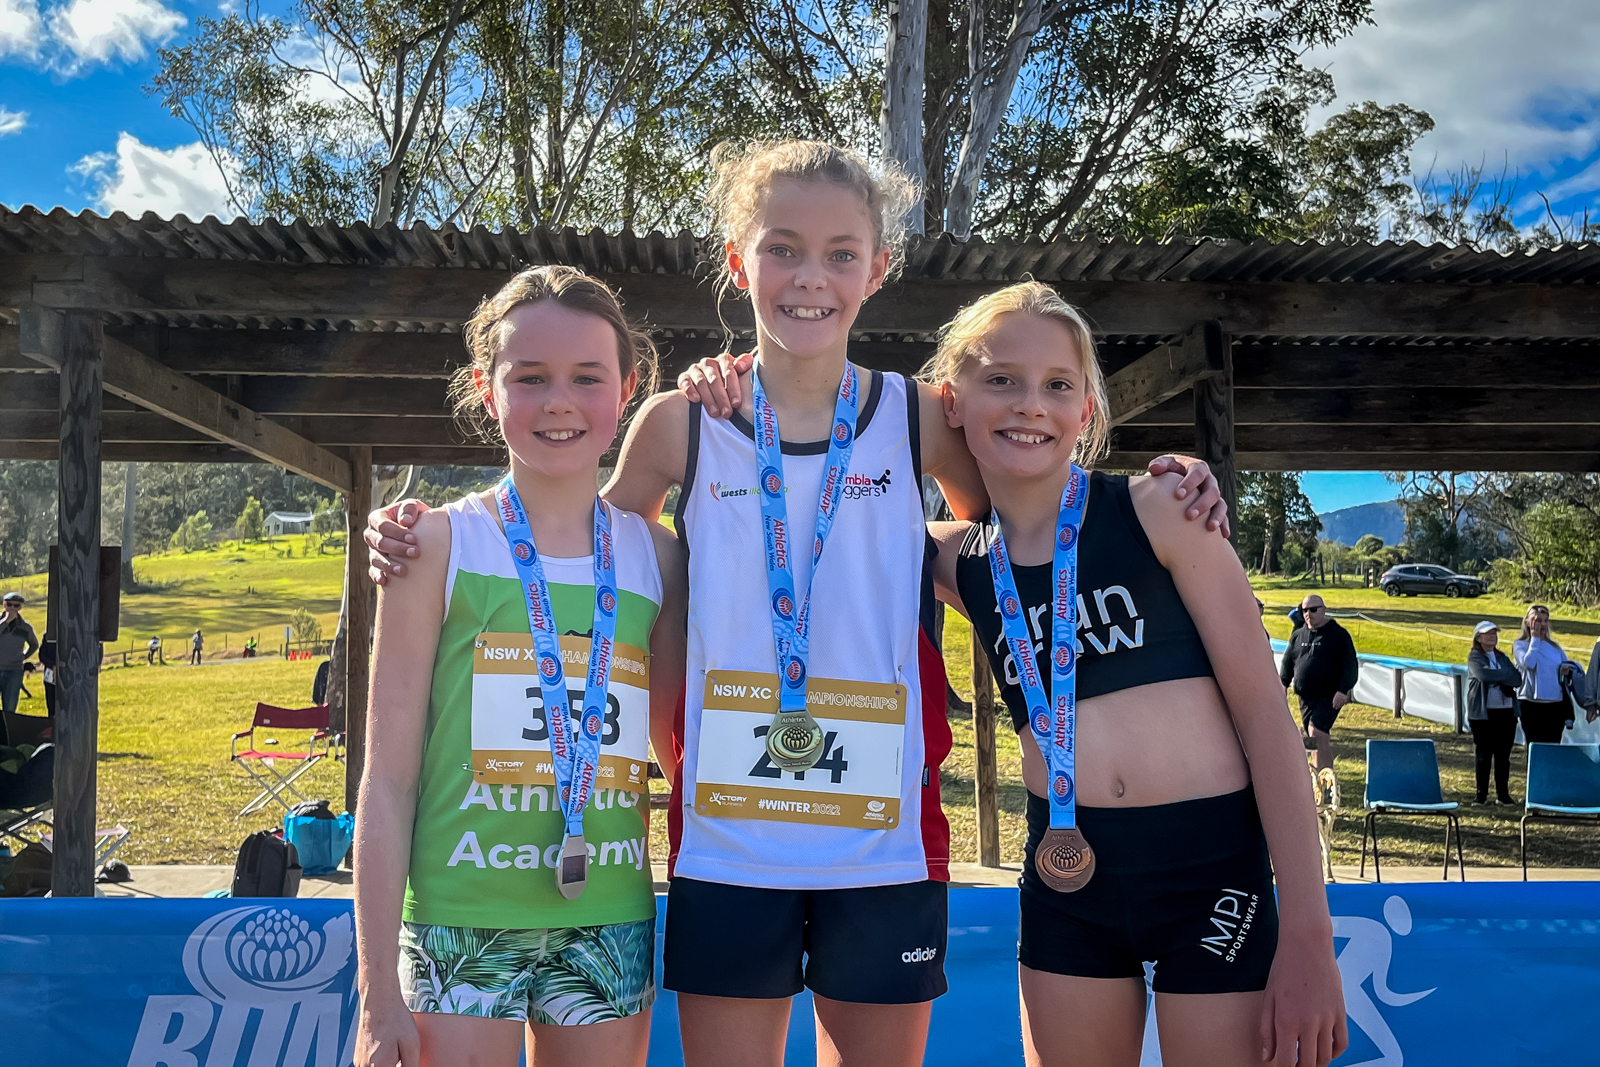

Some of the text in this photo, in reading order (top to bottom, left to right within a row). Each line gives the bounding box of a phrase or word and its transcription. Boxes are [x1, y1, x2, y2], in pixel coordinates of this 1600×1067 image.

[762, 400, 776, 448] Athletics
[721, 488, 748, 498] wests
[819, 465, 838, 516] Athletics
[827, 505, 836, 521] New
[832, 485, 841, 505] South
[1064, 472, 1080, 509] Athletics
[601, 528, 612, 572] Athletics
[773, 518, 788, 569] Athletics
[993, 537, 1006, 575] thletics
[528, 582, 546, 631] Athletics
[543, 598, 552, 618] South
[1056, 569, 1068, 620] Athletics
[547, 619, 555, 635] New
[484, 647, 520, 660] NSW
[596, 635, 612, 688] Athletics
[1008, 637, 1016, 653] New
[1014, 653, 1024, 673] South
[1015, 637, 1037, 688] Athletics
[712, 684, 747, 699] NSW
[750, 686, 772, 700] XC
[551, 705, 567, 759] Athletics
[563, 724, 573, 744] South
[1054, 695, 1067, 749] Athletics
[1066, 692, 1074, 754] New South Wales
[574, 755, 583, 775] New
[747, 725, 848, 784] 24
[571, 775, 580, 796] South
[574, 761, 595, 814] Athletics
[758, 798, 841, 816] #WINTER 2022
[1200, 887, 1249, 957] IMPI
[1225, 894, 1259, 963] SPORTSWEAR
